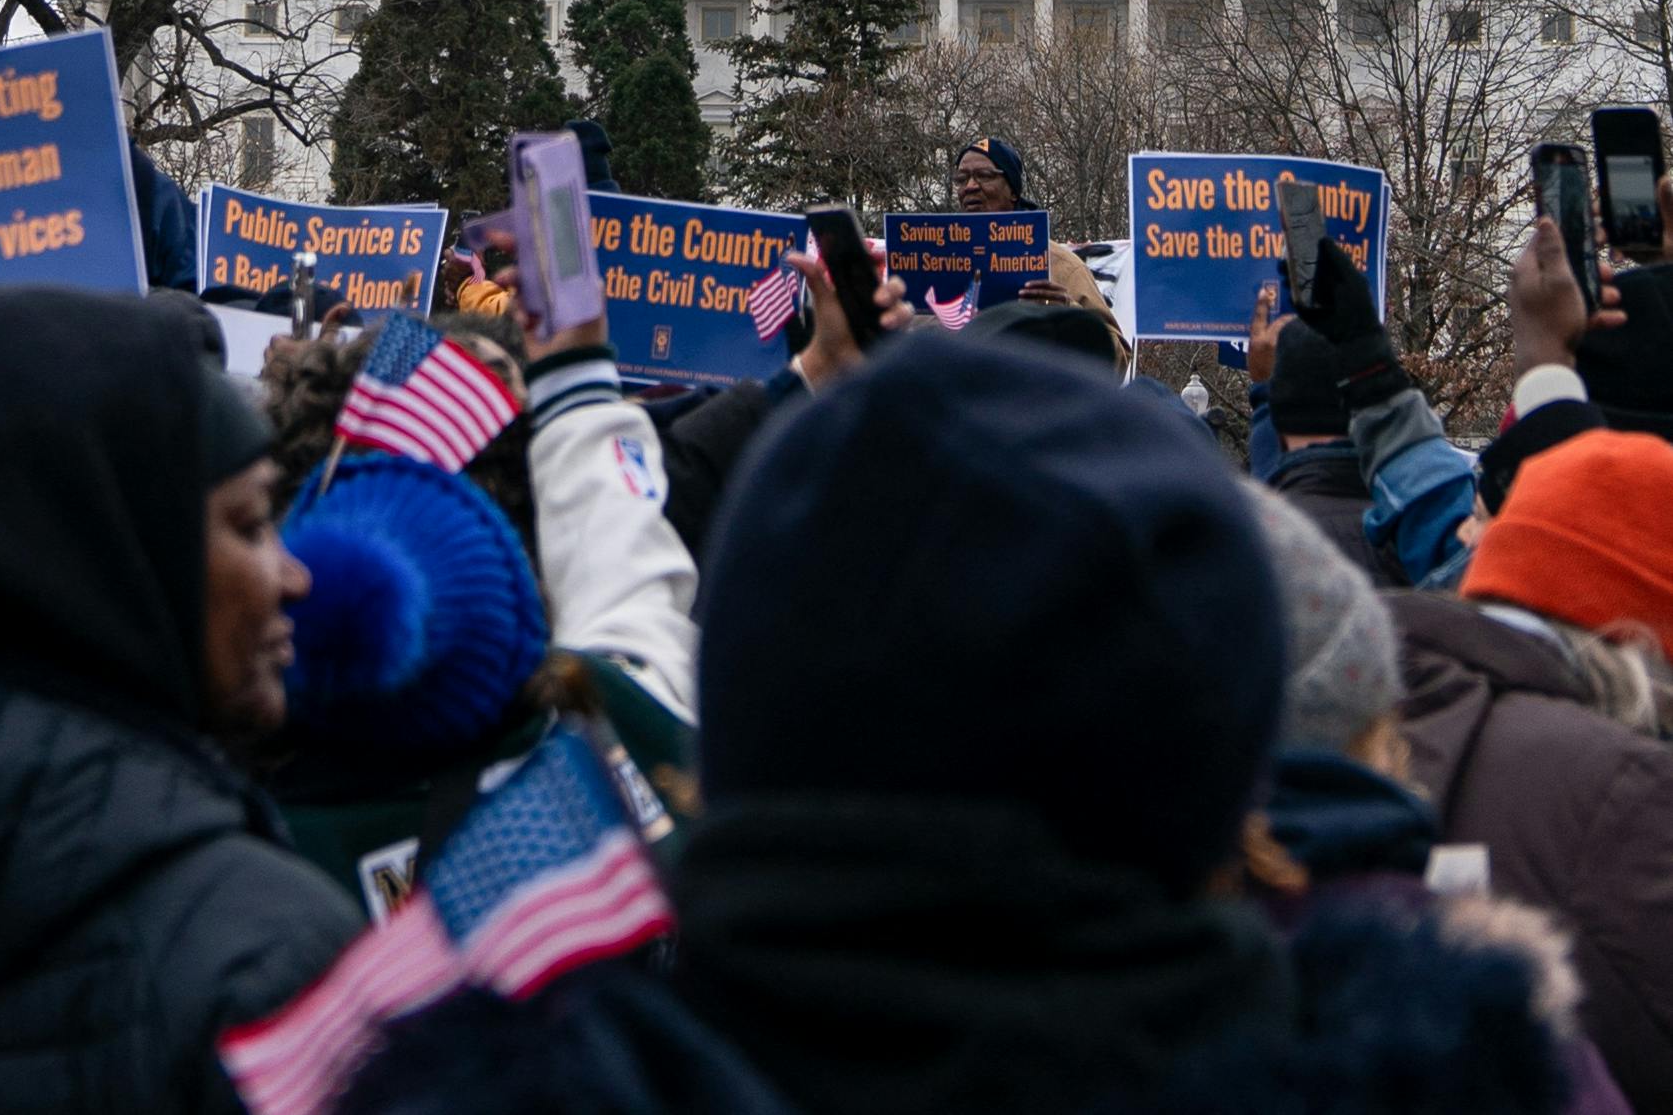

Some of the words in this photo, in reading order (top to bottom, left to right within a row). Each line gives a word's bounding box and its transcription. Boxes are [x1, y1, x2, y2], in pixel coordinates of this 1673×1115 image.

[1146, 167, 1217, 211] Save
[1222, 168, 1272, 212] the
[224, 198, 300, 251] Public
[302, 215, 395, 257] Service
[398, 219, 424, 256] is
[588, 215, 623, 252] ve
[628, 212, 677, 259] the
[900, 221, 946, 246] Saving
[948, 222, 972, 242] the
[988, 221, 1035, 246] Saving
[1145, 222, 1201, 259] Save
[1205, 223, 1244, 259] the
[1248, 223, 1287, 260] Civ
[212, 255, 229, 285] a
[232, 253, 288, 295] Bad
[345, 270, 424, 310] Hono!
[889, 251, 920, 272] Civil
[921, 252, 972, 273] Service
[989, 251, 1049, 273] America!
[603, 265, 643, 302] the
[645, 269, 697, 307] Civil
[698, 275, 756, 316] Serv
